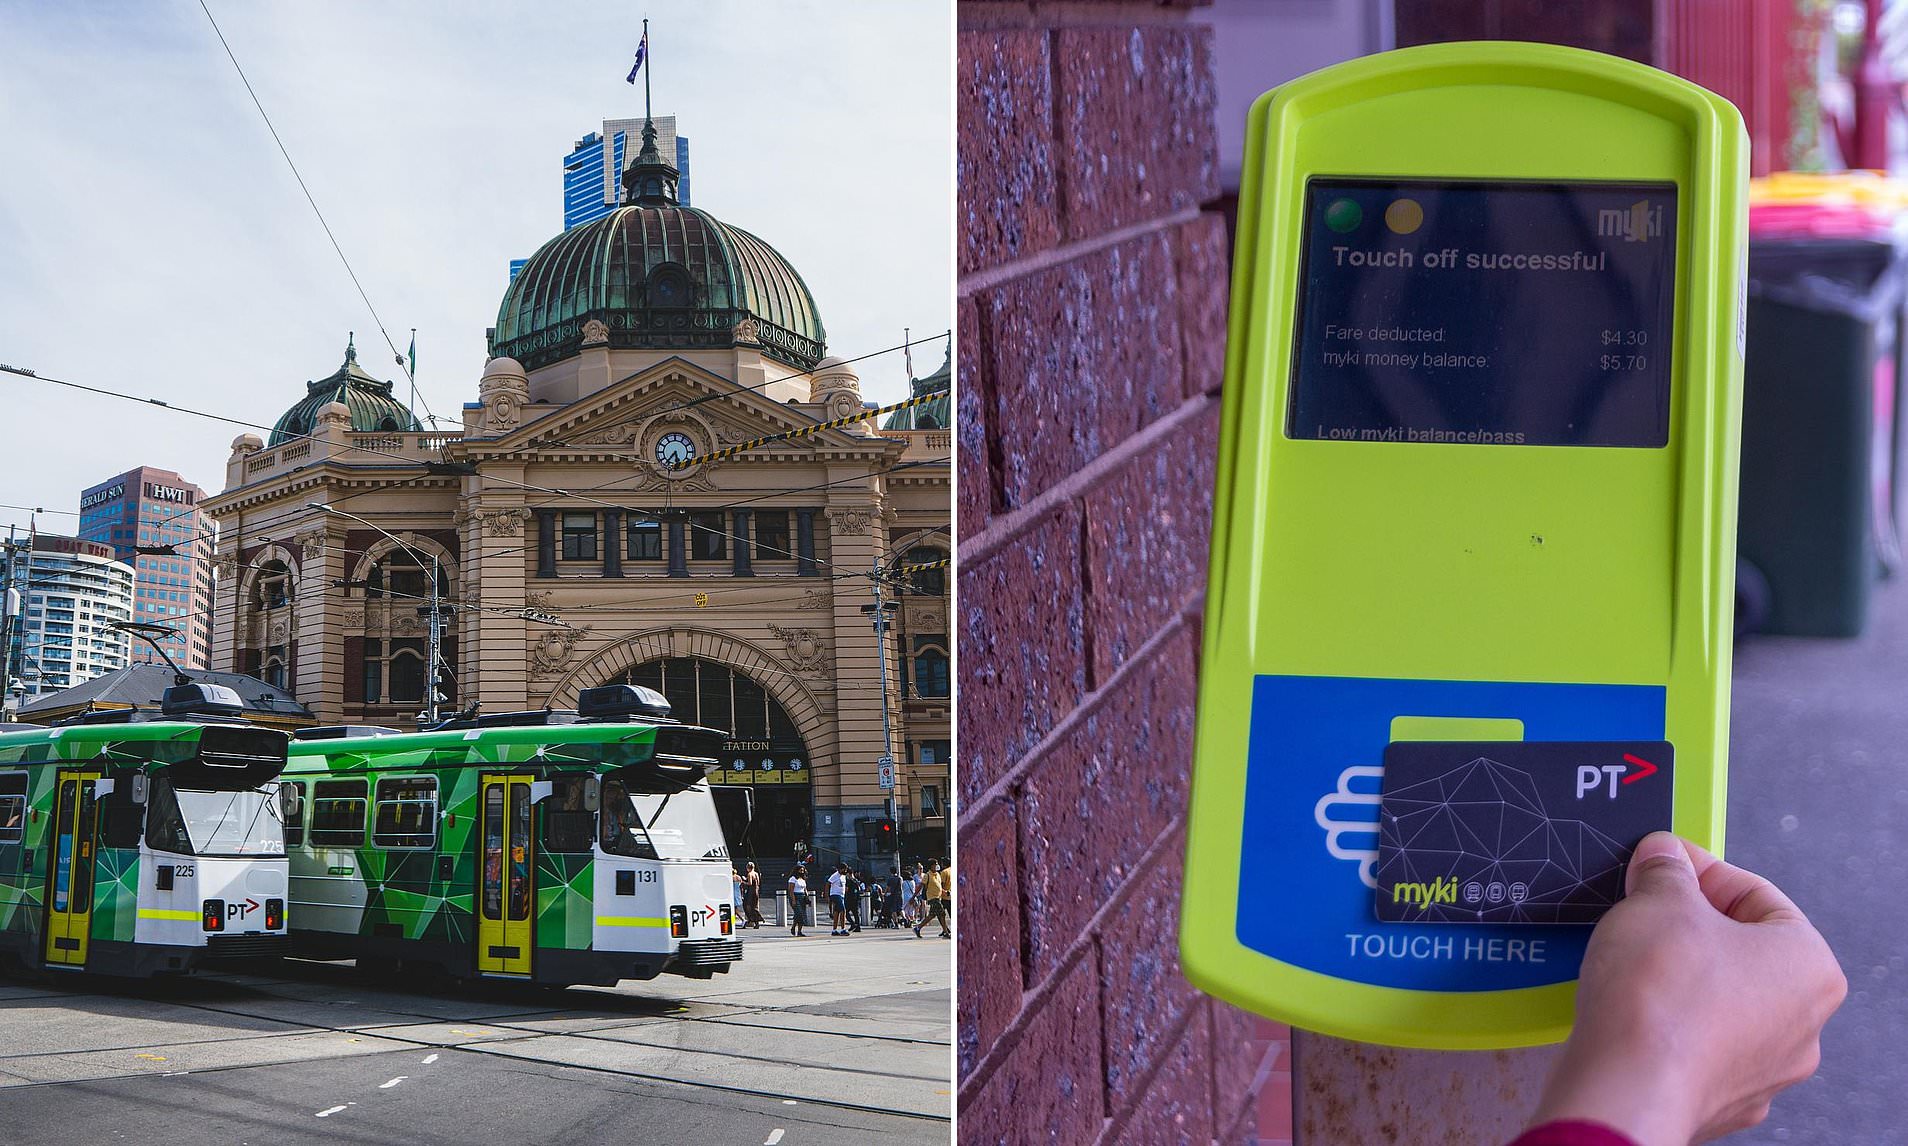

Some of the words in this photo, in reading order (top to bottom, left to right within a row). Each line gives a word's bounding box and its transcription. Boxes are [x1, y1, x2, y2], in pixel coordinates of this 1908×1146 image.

[1599, 202, 1663, 242] myki
[1332, 246, 1413, 268] Touch
[1423, 248, 1459, 268] off
[1466, 252, 1605, 271] successful
[1325, 324, 1363, 340] Fare
[1368, 326, 1447, 342] deducted:
[1601, 329, 1648, 346] $4.30
[1323, 351, 1360, 367] myki
[1365, 352, 1419, 369] money
[1423, 352, 1490, 368] balance:
[1600, 355, 1648, 371] $5.70
[1317, 425, 1356, 439] Low
[1361, 426, 1402, 442] myki
[1408, 427, 1525, 444] balance/pass
[108, 484, 125, 499] SUN
[88, 543, 109, 558] WEST
[725, 741, 769, 751] TATION
[260, 840, 283, 853] 225
[176, 865, 194, 878] 225
[638, 870, 657, 882] 131
[1393, 876, 1459, 909] myki
[1345, 934, 1453, 959] TOUCH
[1464, 937, 1547, 963] HERE
